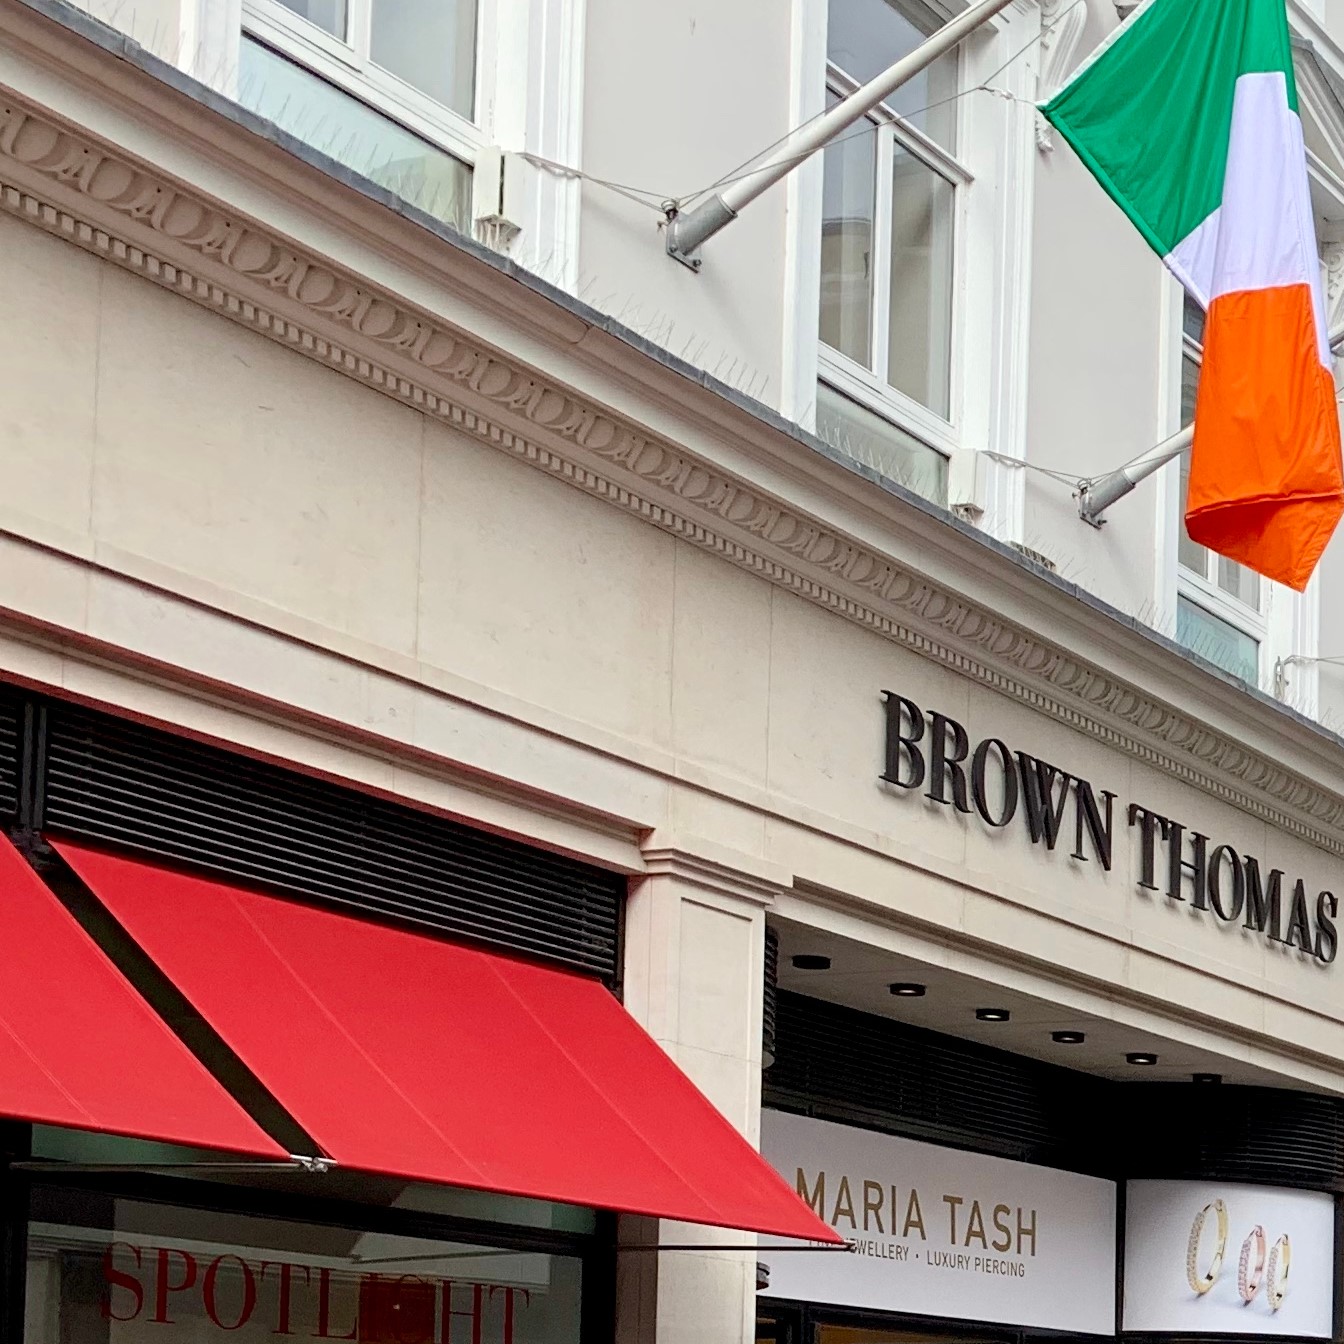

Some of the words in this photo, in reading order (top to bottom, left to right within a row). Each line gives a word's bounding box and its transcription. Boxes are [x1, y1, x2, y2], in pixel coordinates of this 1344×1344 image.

[879, 689, 1118, 871] BROWN
[1128, 803, 1339, 964] THOMAS
[796, 1167, 927, 1240] MARIA
[942, 1194, 1037, 1257] TASH
[845, 1238, 909, 1262] WELLERY
[926, 1250, 970, 1271] LUXURY
[974, 1257, 1025, 1278] PIERCING
